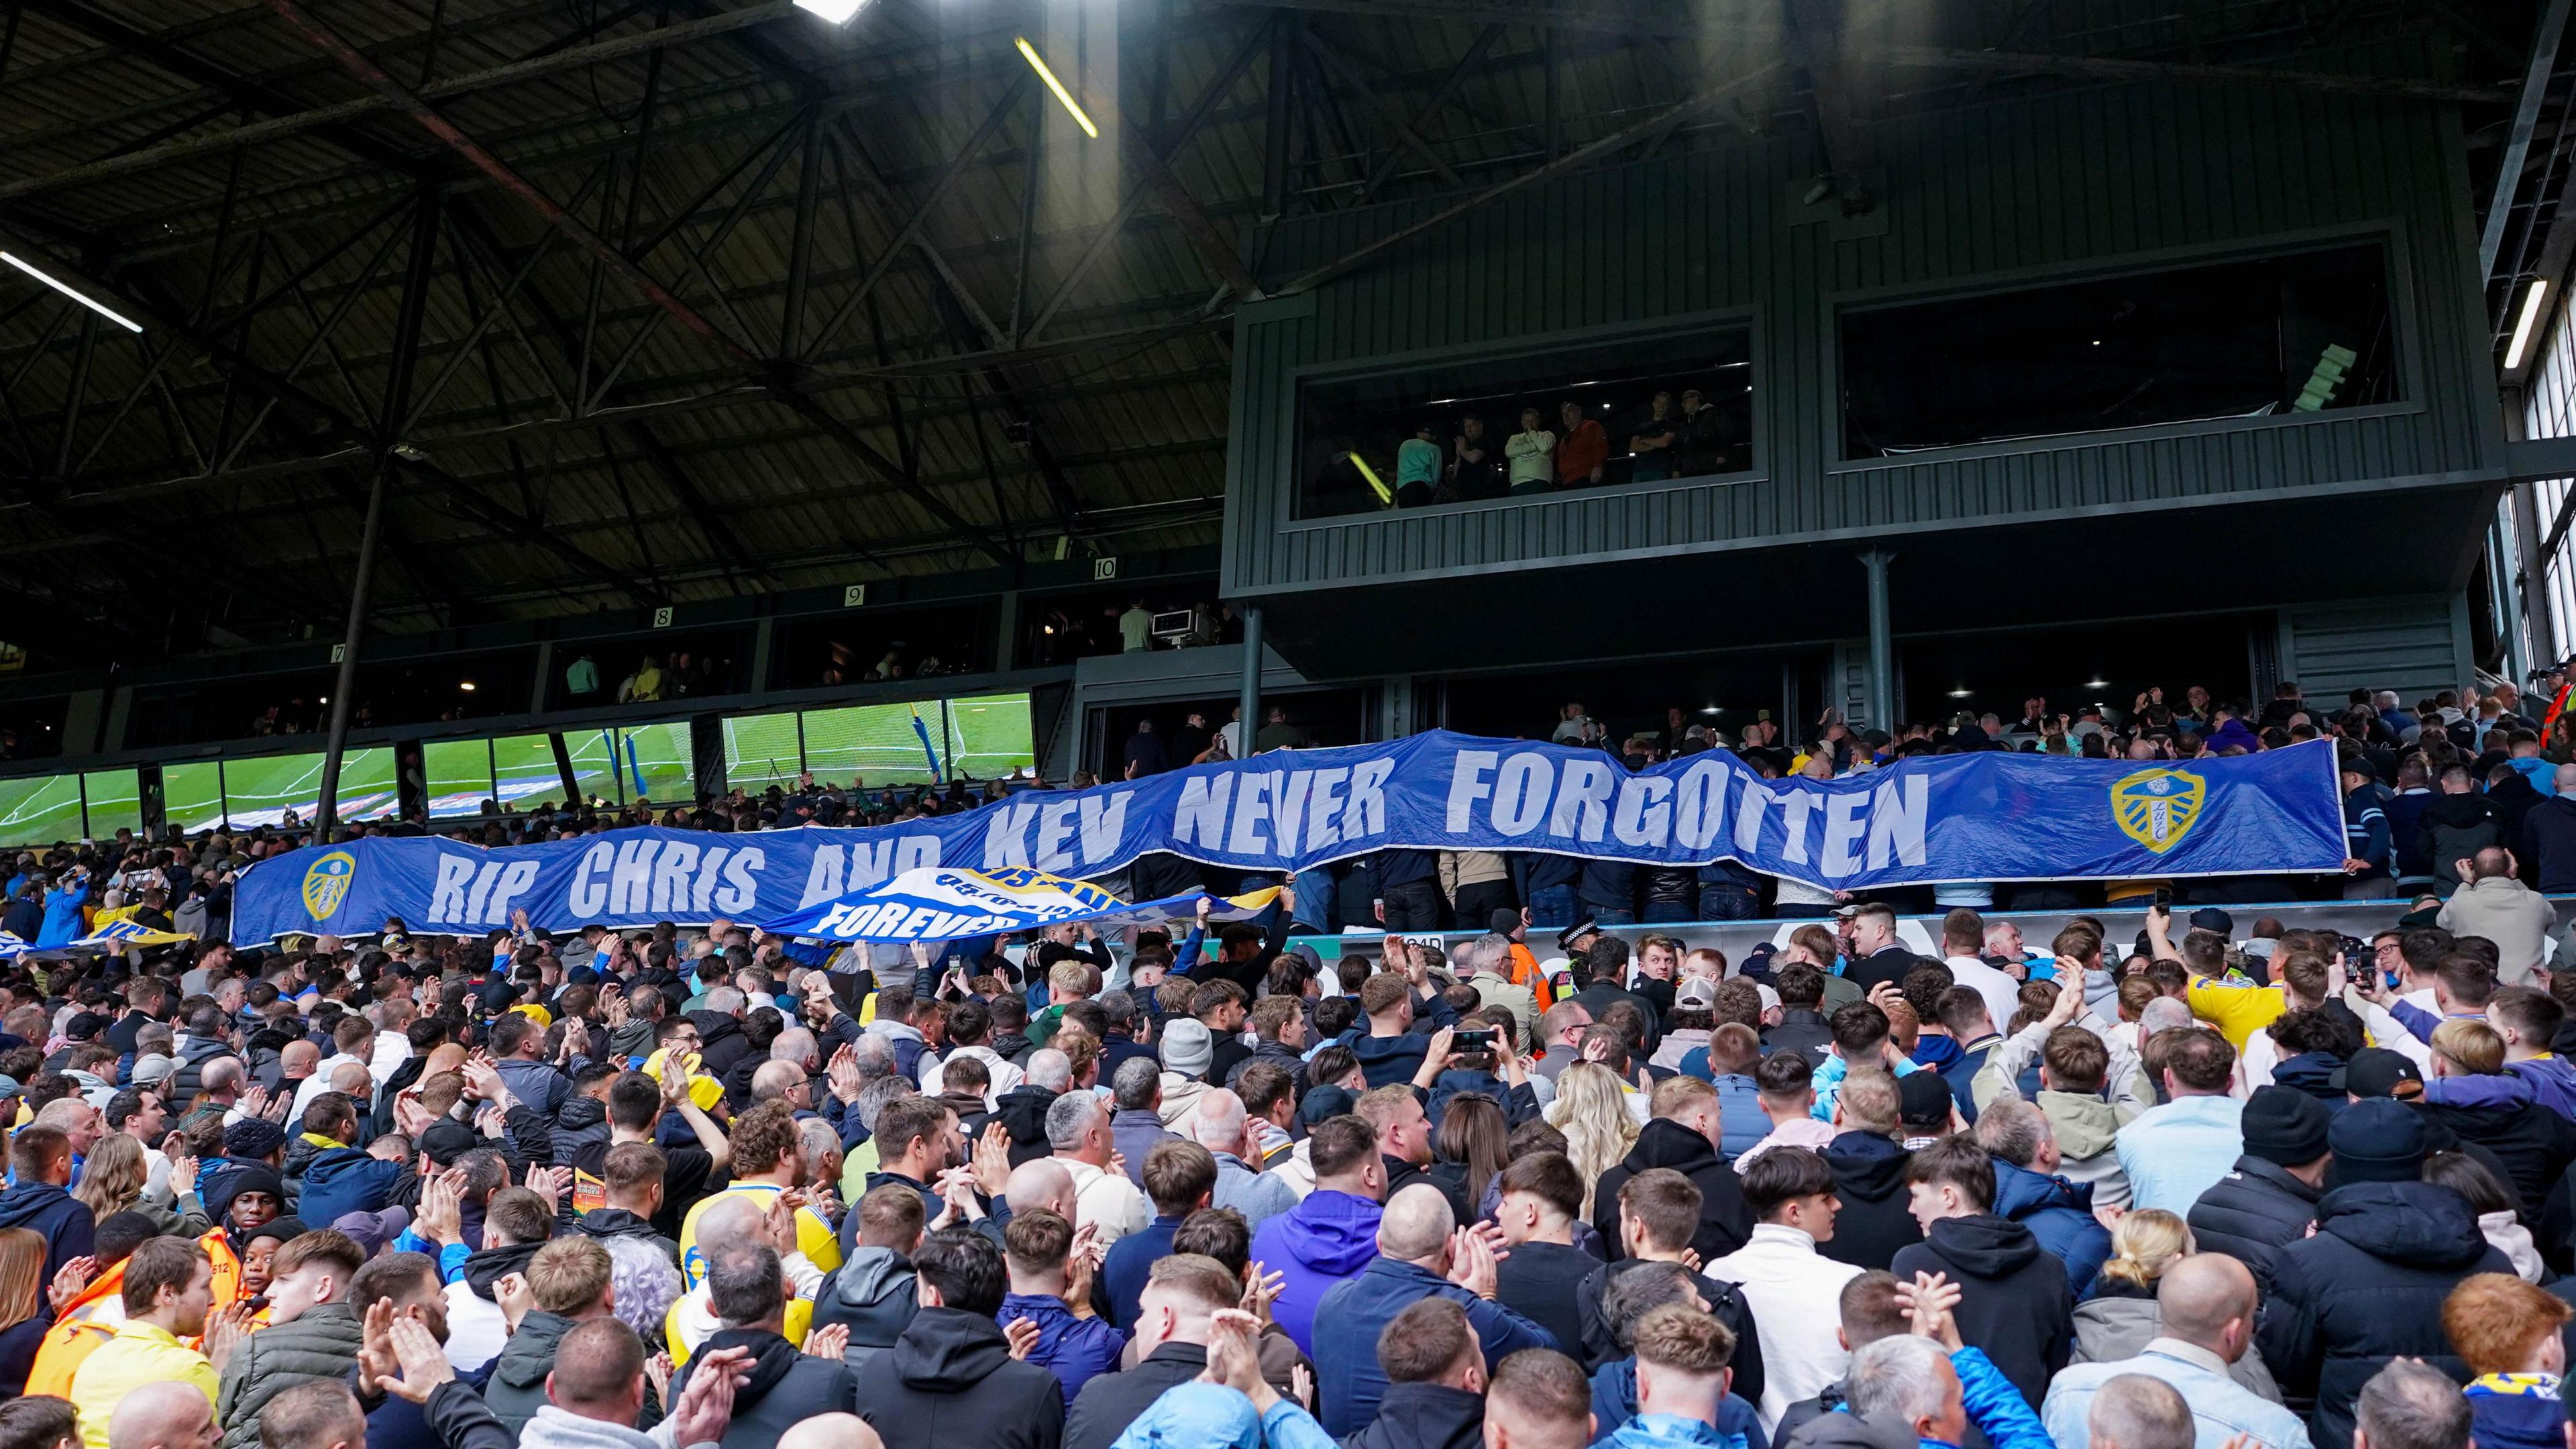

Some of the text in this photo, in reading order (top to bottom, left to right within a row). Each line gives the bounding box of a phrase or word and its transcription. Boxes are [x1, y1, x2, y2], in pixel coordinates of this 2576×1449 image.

[1096, 560, 1115, 577] 10
[850, 588, 860, 604] 9
[657, 610, 668, 625] 8
[336, 647, 344, 660] 7
[427, 750, 1929, 924] RIP CHRIS AND KEV NEVER FORGOTTEN
